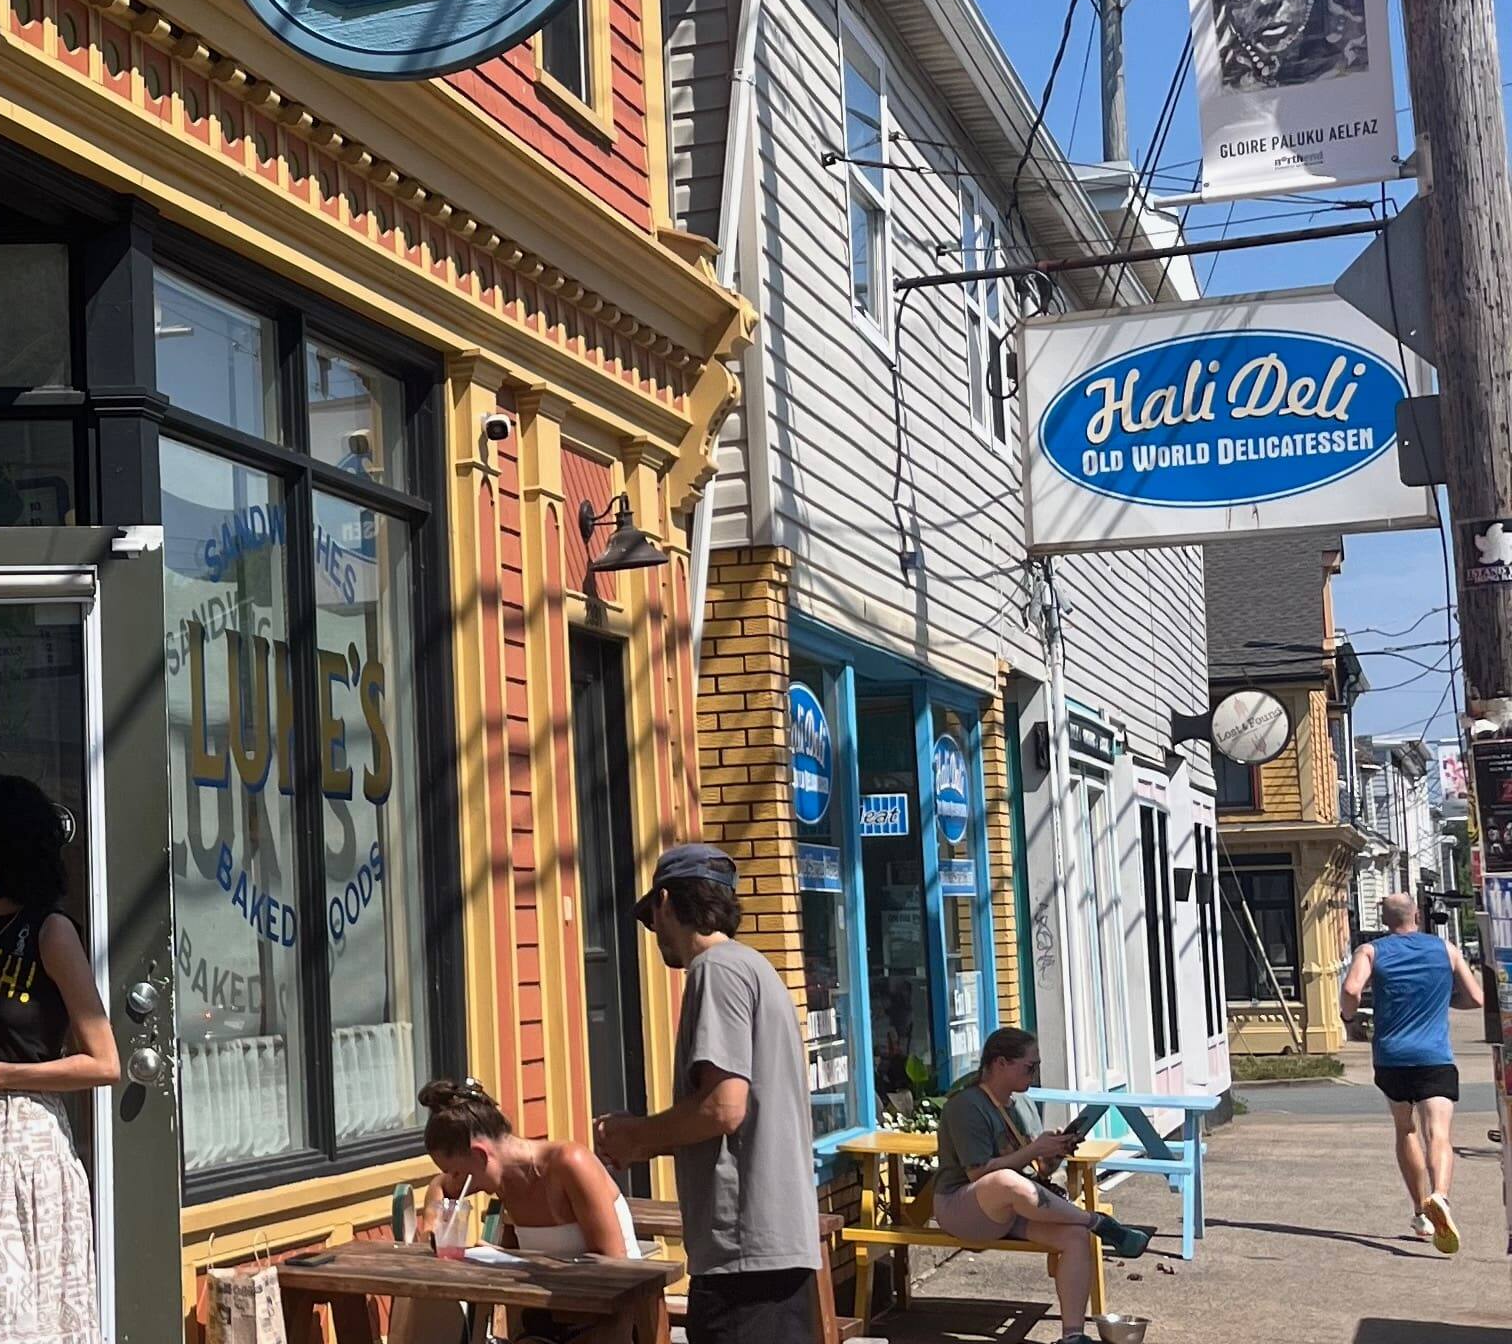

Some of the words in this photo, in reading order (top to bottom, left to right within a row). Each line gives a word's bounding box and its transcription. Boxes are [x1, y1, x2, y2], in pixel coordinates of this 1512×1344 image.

[1219, 138, 1267, 159] GLOIRE
[1271, 129, 1324, 151] PALUKU
[1328, 119, 1379, 142] AELFAZ
[1085, 359, 1220, 445] Hali
[1227, 353, 1367, 422] Deli
[1081, 449, 1123, 477] OLD
[1132, 442, 1210, 472] WORLD
[1217, 427, 1374, 465] DELICATESSEN
[859, 805, 900, 825] eat
[216, 839, 297, 948] BAKED
[328, 840, 386, 941] OODS
